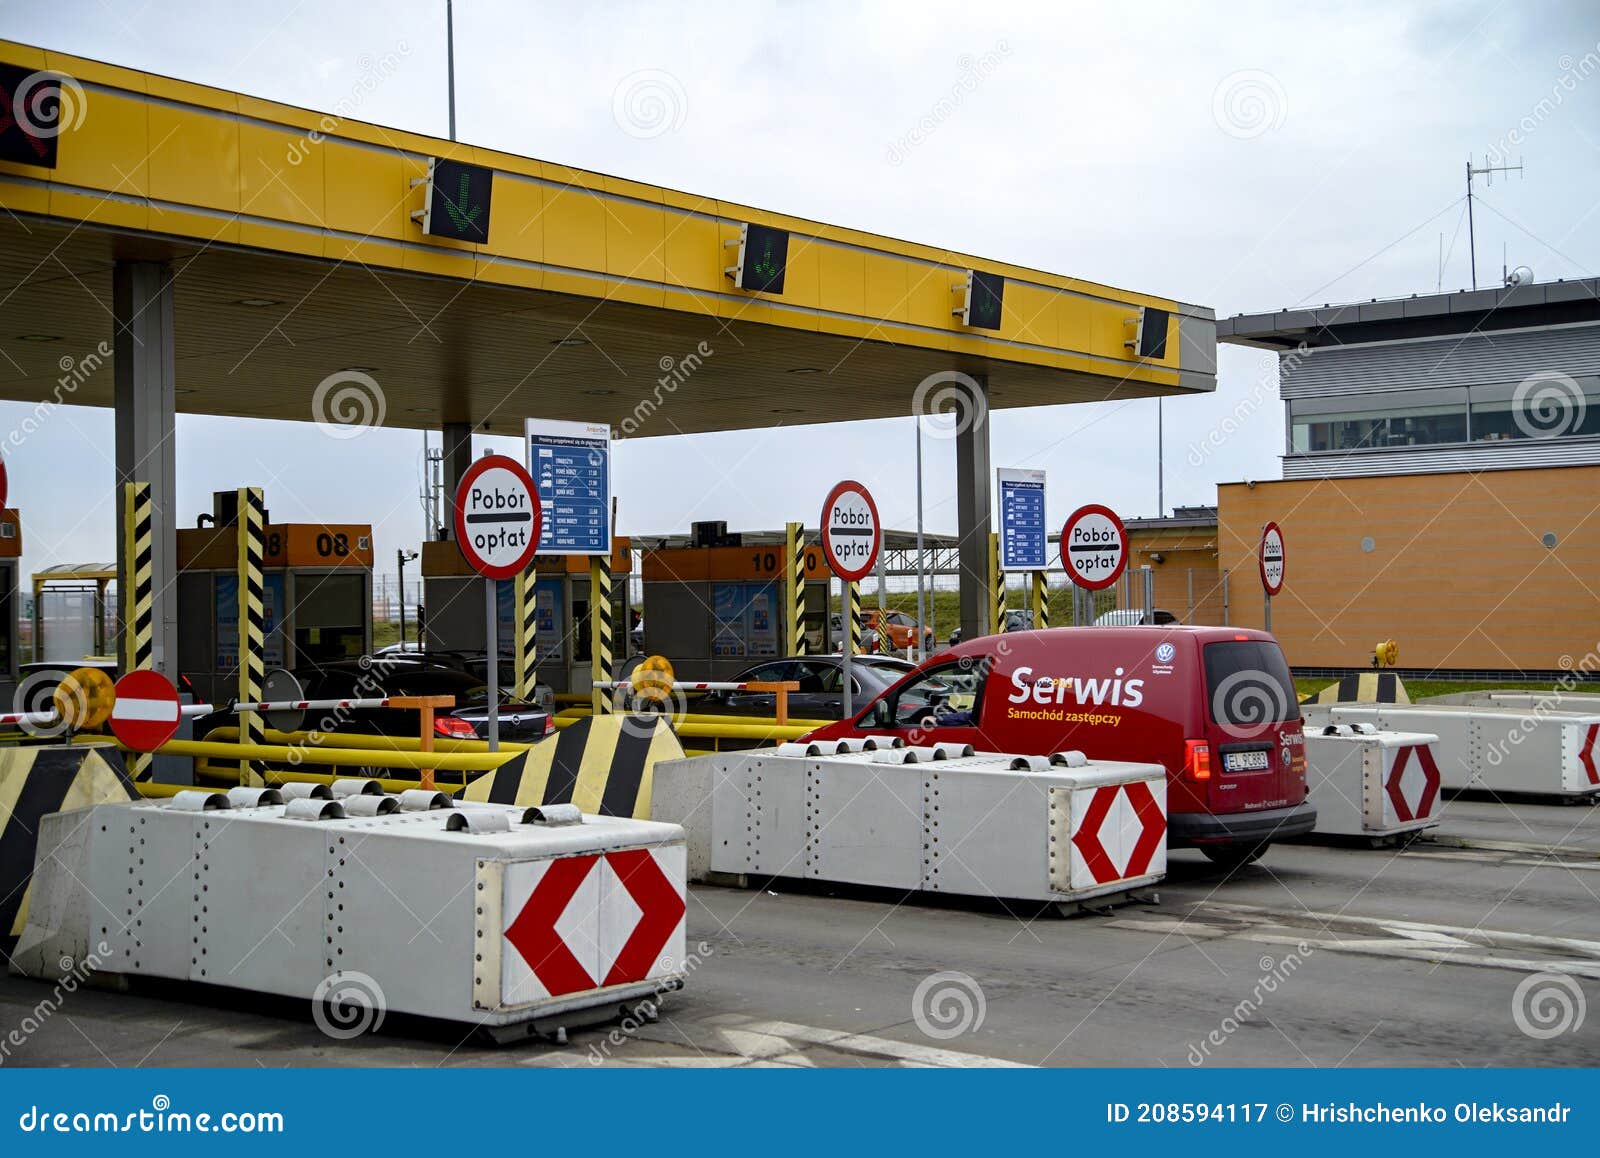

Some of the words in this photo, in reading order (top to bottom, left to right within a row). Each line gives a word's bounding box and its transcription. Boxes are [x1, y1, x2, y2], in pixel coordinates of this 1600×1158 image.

[472, 488, 524, 509] Pobór
[834, 507, 870, 525] Pobór
[475, 527, 526, 554] opłat
[1074, 527, 1115, 542] Pobór
[316, 533, 349, 557] 08
[836, 539, 869, 561] opłat
[1266, 541, 1280, 554] Pobór
[752, 553, 776, 572] 10
[1076, 554, 1115, 573] opłat
[1267, 564, 1280, 580] opłat
[1008, 666, 1144, 707] Serwis
[1008, 708, 1064, 721] Samochód
[1066, 711, 1121, 726] zastępczy
